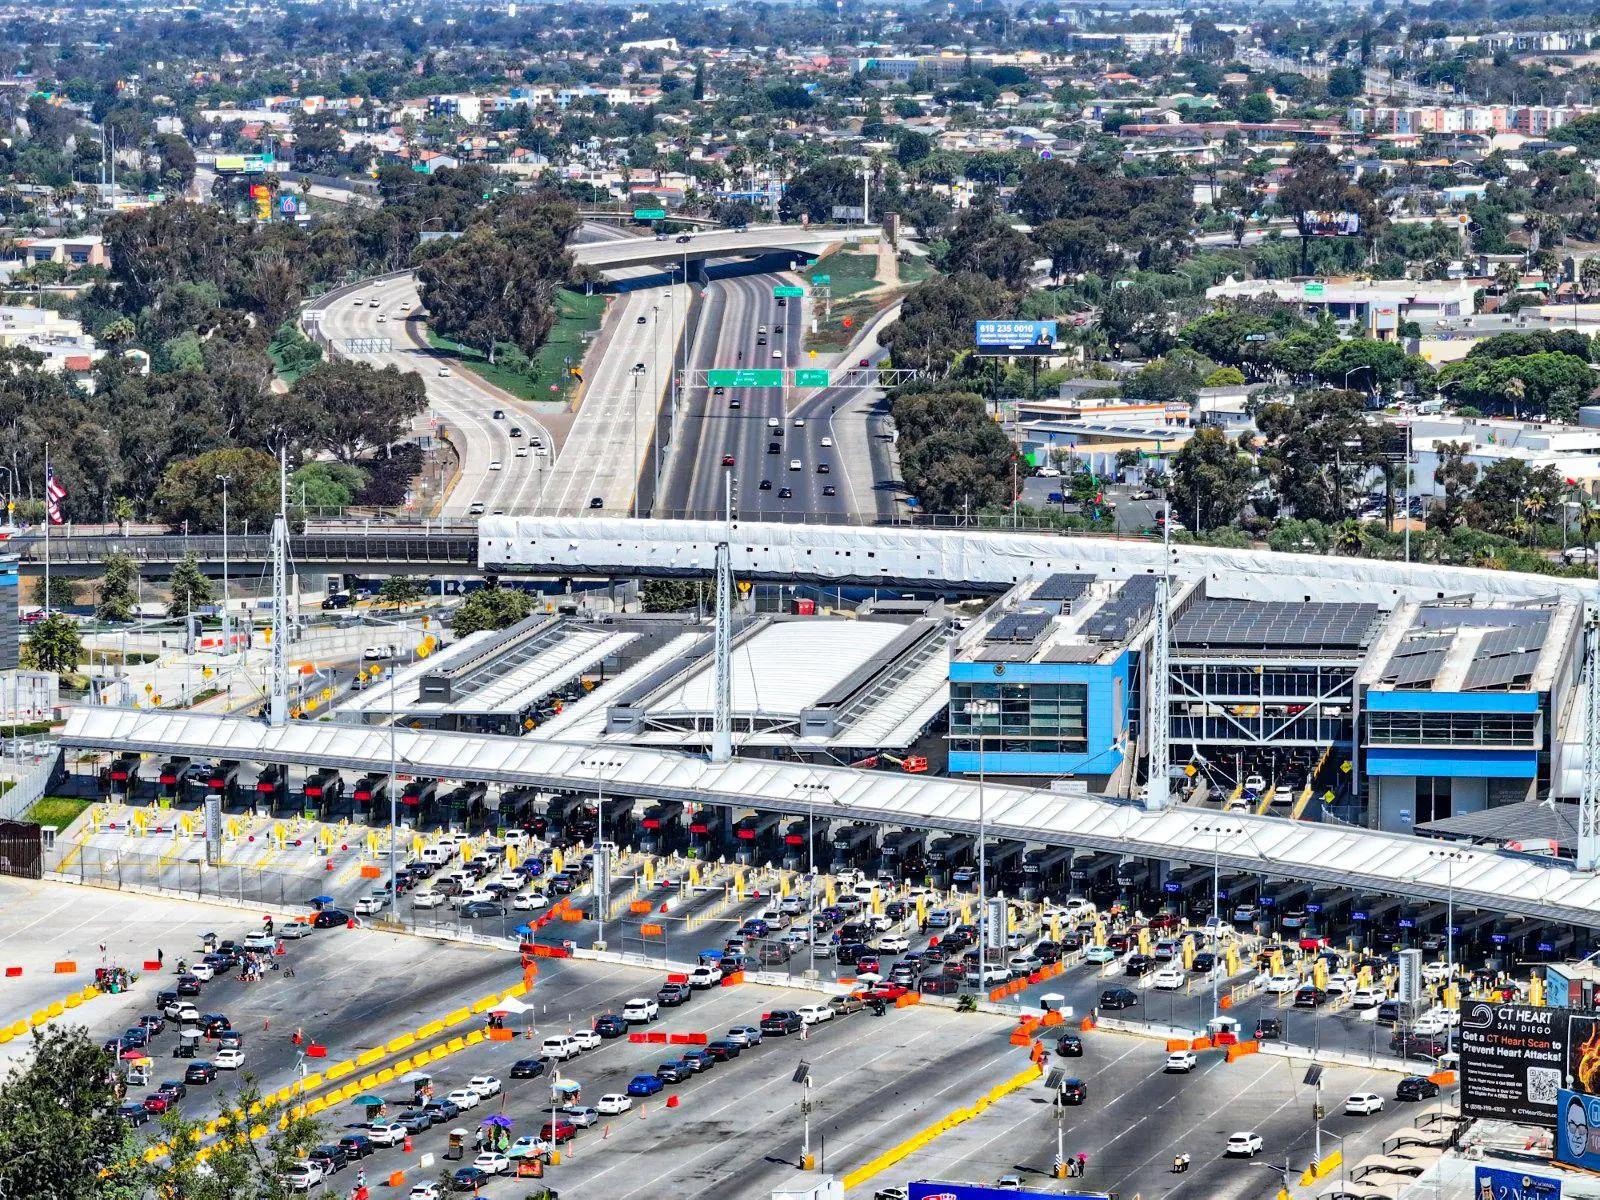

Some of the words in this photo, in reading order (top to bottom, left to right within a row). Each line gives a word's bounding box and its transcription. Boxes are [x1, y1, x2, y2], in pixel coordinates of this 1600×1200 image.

[1014, 325, 1033, 333] 0010
[1498, 1008, 1514, 1020] CT
[1516, 1009, 1552, 1024] HEART
[1498, 1022, 1516, 1031] SAN
[1521, 1025, 1551, 1035] DIEGO
[1463, 1031, 1477, 1041] Get
[1487, 1034, 1499, 1043] CT
[1501, 1036, 1525, 1046] Heart
[1527, 1039, 1550, 1048] Scan
[1552, 1041, 1562, 1050] to
[1463, 1043, 1494, 1055] Prevent
[1497, 1047, 1521, 1057] Heart
[1524, 1050, 1562, 1061] Attacks!
